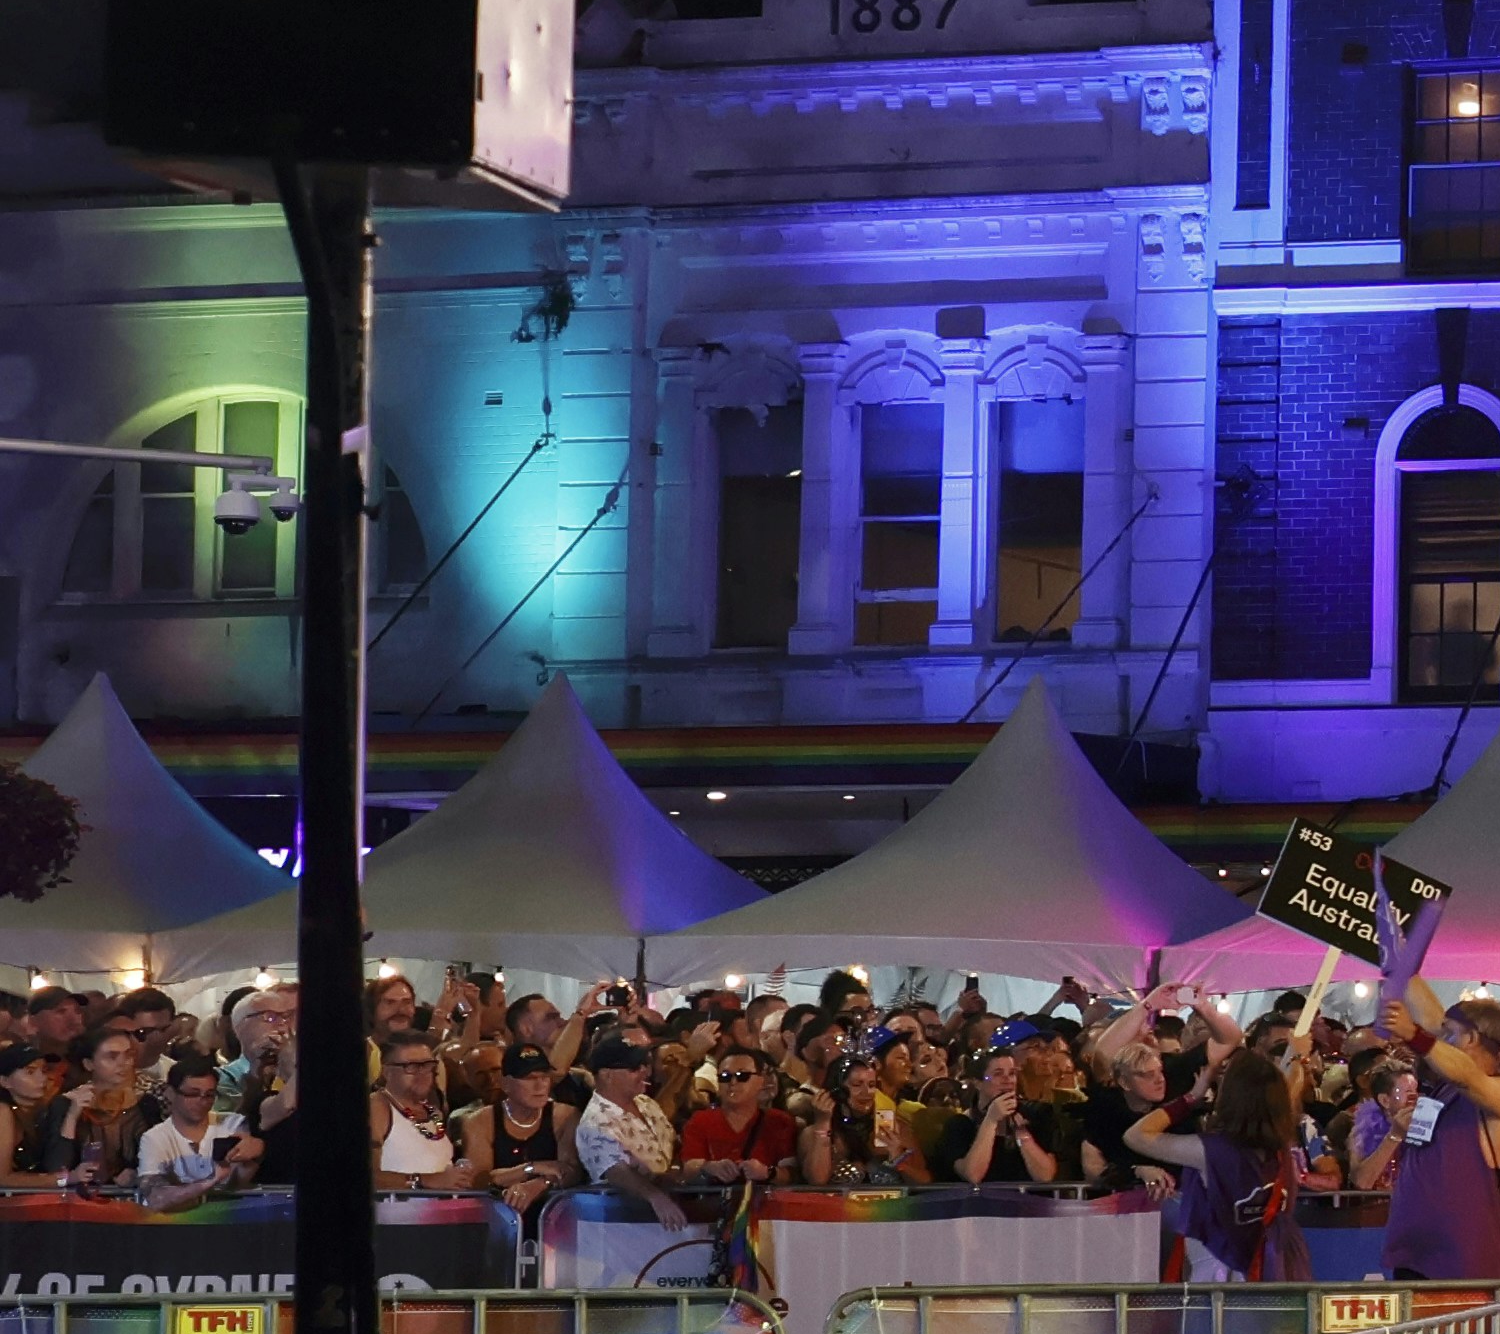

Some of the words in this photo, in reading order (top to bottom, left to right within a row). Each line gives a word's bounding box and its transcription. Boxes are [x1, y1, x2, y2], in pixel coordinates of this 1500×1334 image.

[1299, 827, 1333, 851] #53
[1305, 863, 1411, 927] Equaly
[1410, 878, 1442, 902] D01
[1288, 888, 1381, 945] Austra
[187, 1310, 248, 1333] TFH
[1331, 1299, 1386, 1320] TFH
